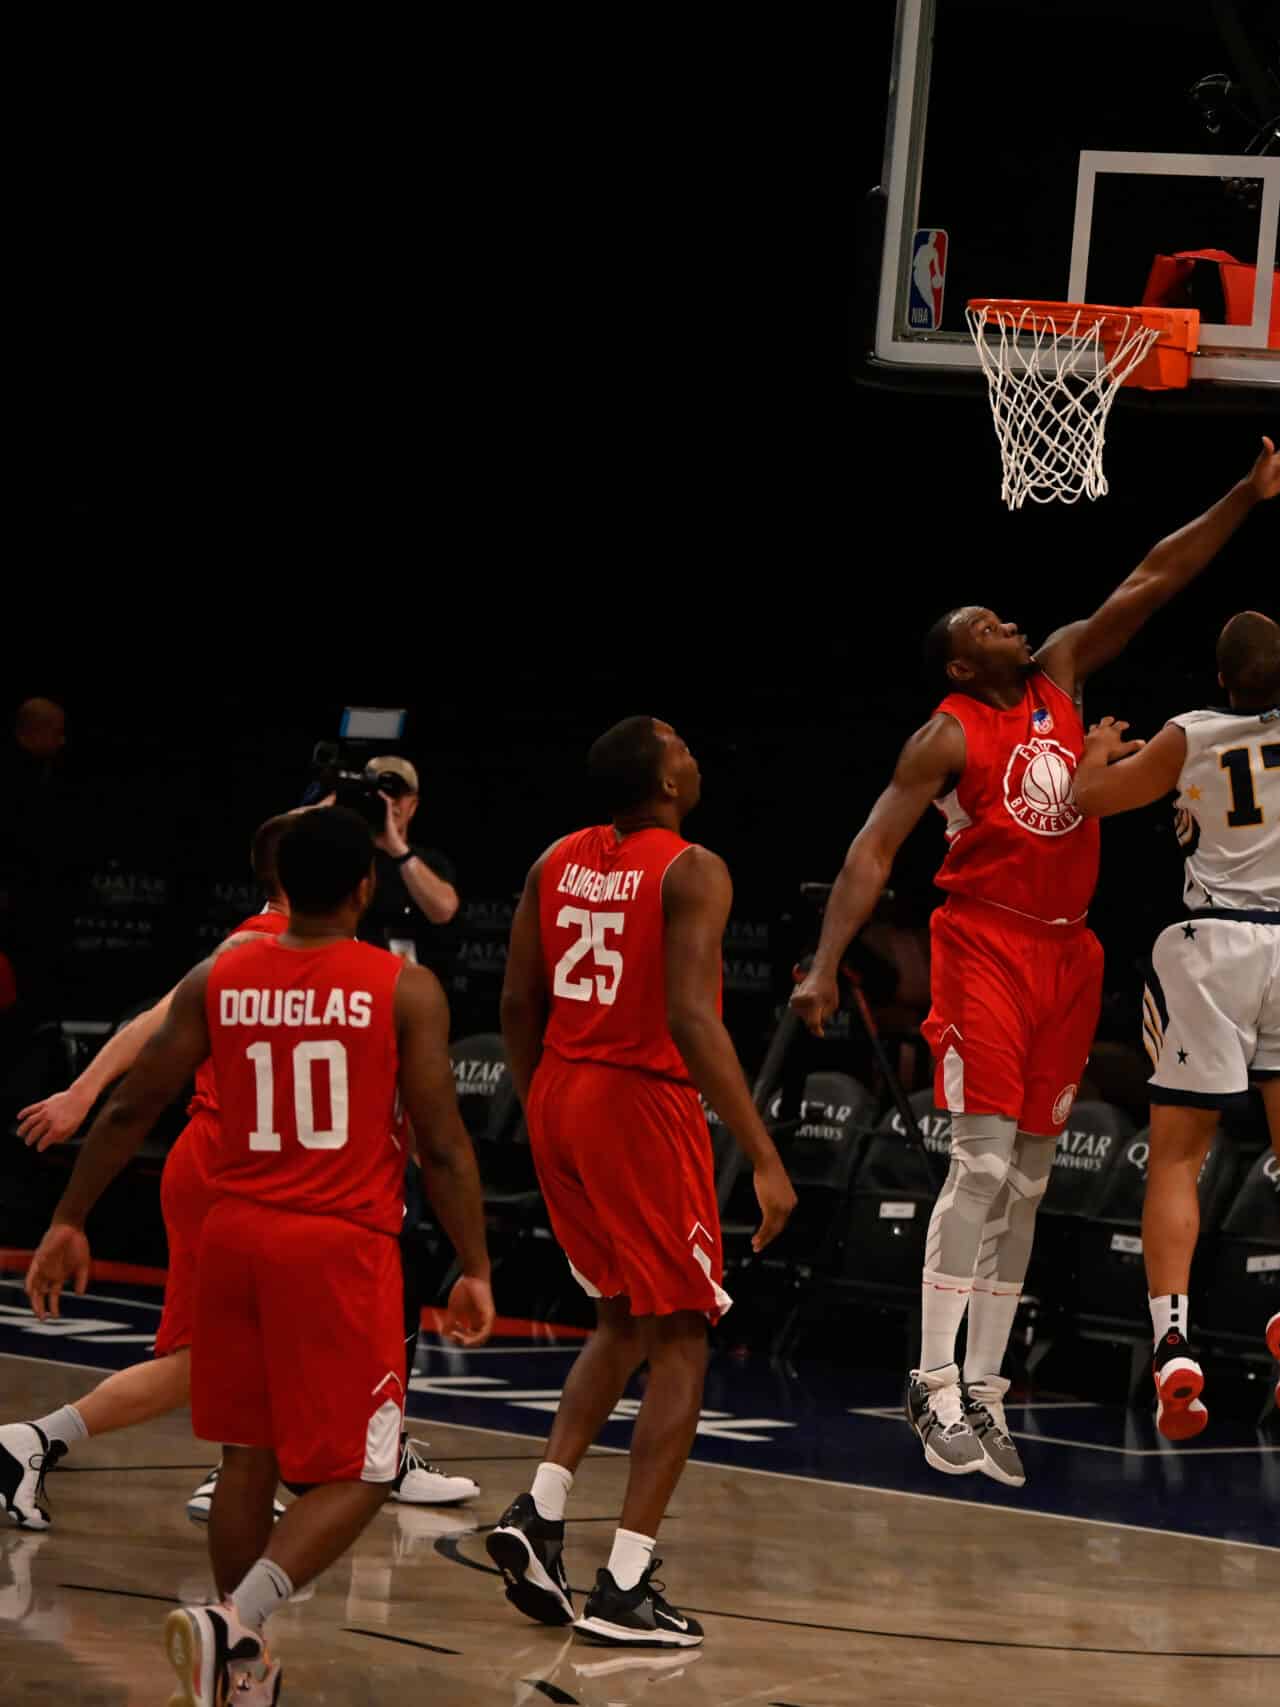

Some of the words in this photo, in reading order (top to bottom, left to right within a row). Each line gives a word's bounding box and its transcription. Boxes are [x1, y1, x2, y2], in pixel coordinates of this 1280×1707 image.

[1009, 795, 1082, 832] BASKETB
[552, 904, 626, 1007] 25
[219, 987, 374, 1029] DOUGLAS
[450, 1058, 507, 1083] ATAR
[245, 1039, 350, 1153] 10
[1056, 1130, 1113, 1158] ATAR
